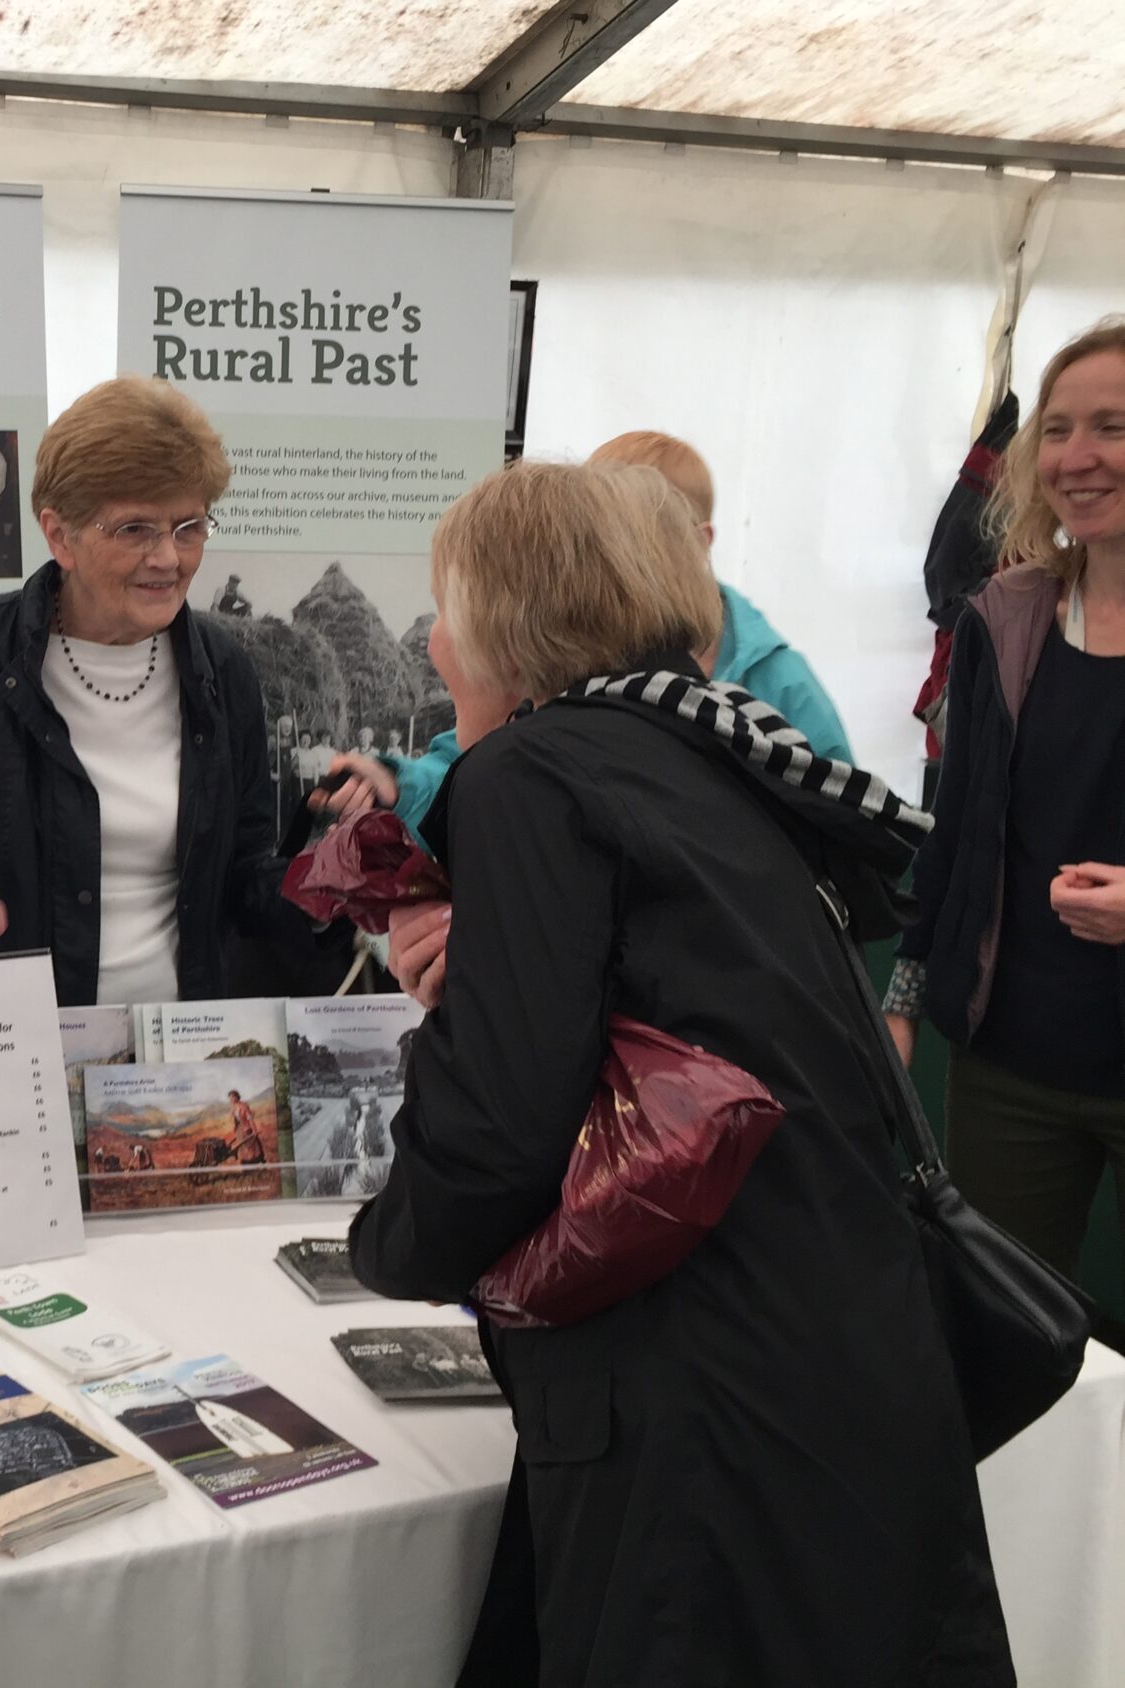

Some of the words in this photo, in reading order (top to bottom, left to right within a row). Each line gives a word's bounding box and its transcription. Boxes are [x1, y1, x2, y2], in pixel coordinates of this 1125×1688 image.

[153, 286, 421, 333] Perthshire's
[153, 335, 292, 383] Rural
[311, 339, 418, 386] Past
[231, 448, 253, 457] vast
[256, 447, 281, 458] rural
[345, 448, 363, 459] the
[366, 449, 403, 463] history
[405, 449, 417, 461] of
[419, 450, 437, 461] the
[240, 464, 270, 476] those
[273, 465, 297, 476] who
[299, 466, 329, 477] make
[332, 466, 357, 477] their
[359, 467, 389, 481] living
[391, 467, 417, 478] from
[420, 468, 438, 479] the
[261, 488, 287, 499] from
[290, 491, 324, 500] across
[326, 492, 345, 500] our
[391, 494, 439, 502] museum
[230, 506, 249, 516] this
[252, 506, 307, 517] exhibition
[309, 507, 365, 518] celebrates
[367, 509, 385, 519] the
[388, 509, 425, 522] history
[217, 524, 241, 534] rural
